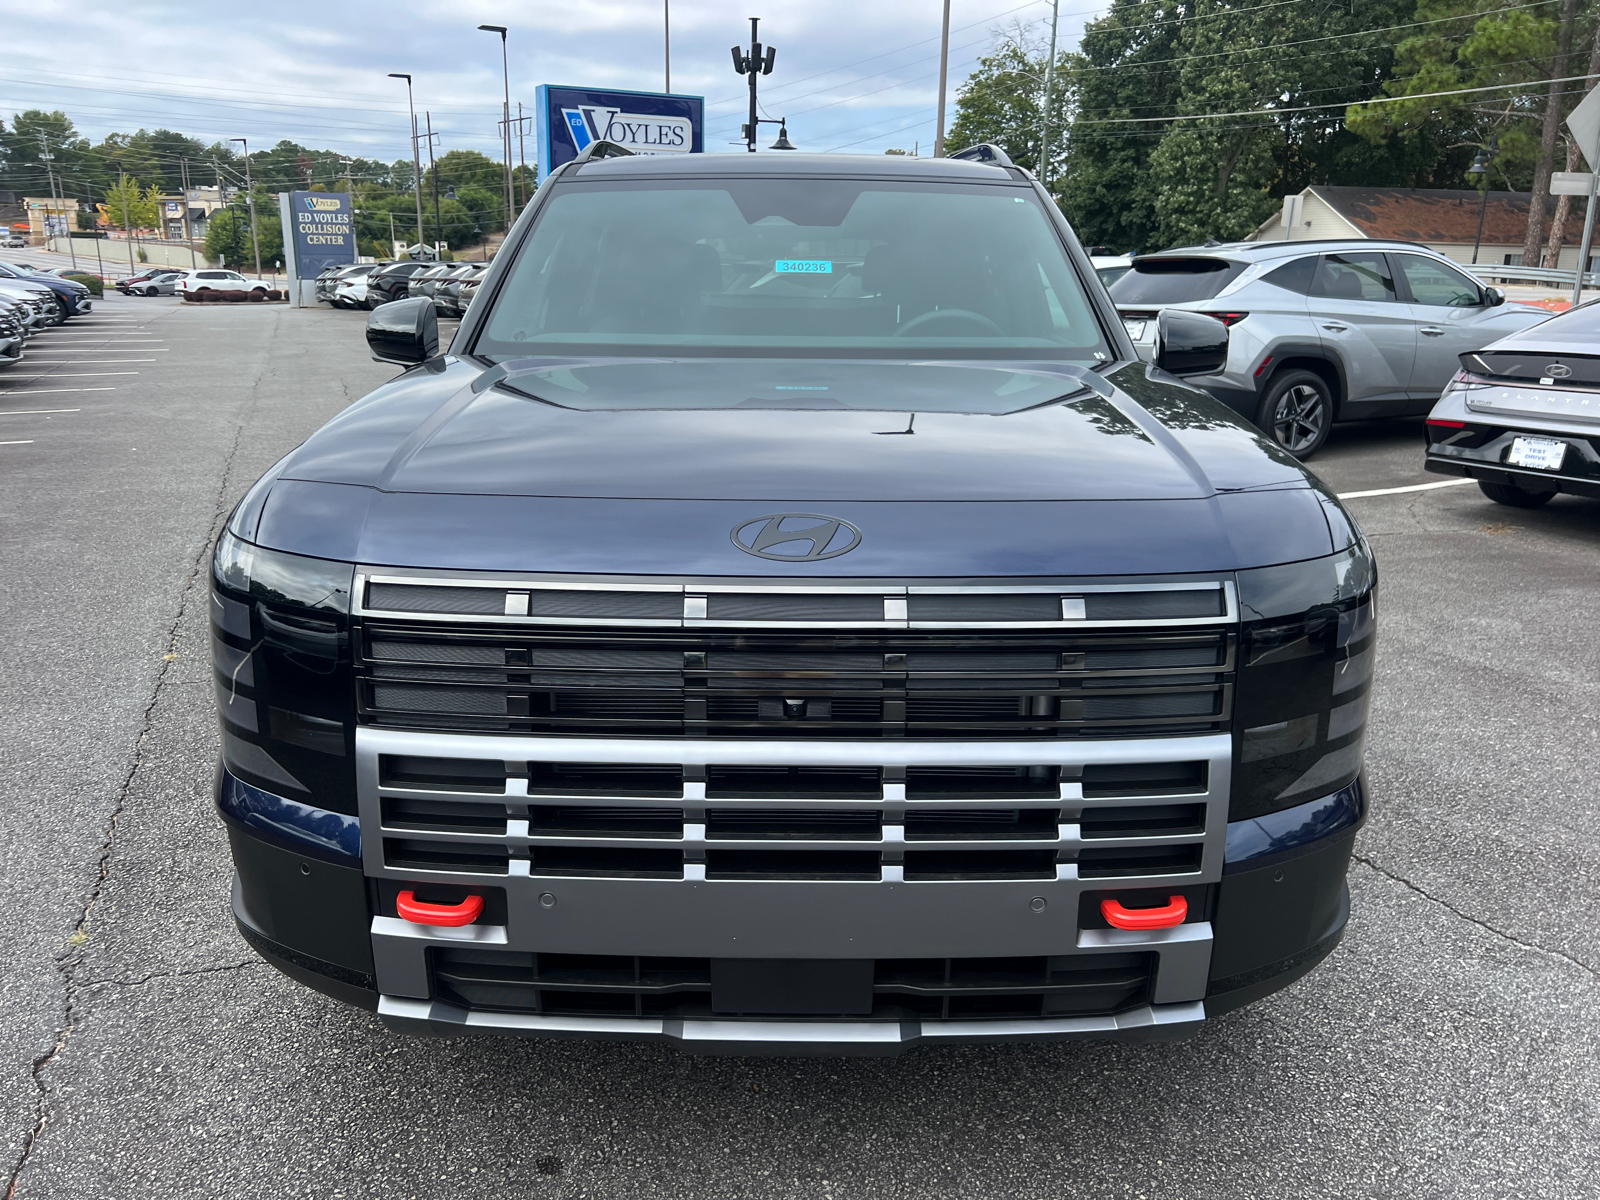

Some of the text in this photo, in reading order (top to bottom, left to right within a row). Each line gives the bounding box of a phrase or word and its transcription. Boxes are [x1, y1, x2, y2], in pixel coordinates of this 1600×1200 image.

[571, 108, 684, 146] ED VOYLES
[309, 198, 339, 208] VOYLES
[298, 212, 349, 223] ED VOYLES
[300, 224, 349, 234] COLLISION
[307, 235, 344, 245] CENTER
[782, 262, 826, 272] 340236
[1502, 392, 1600, 406] ELANTR
